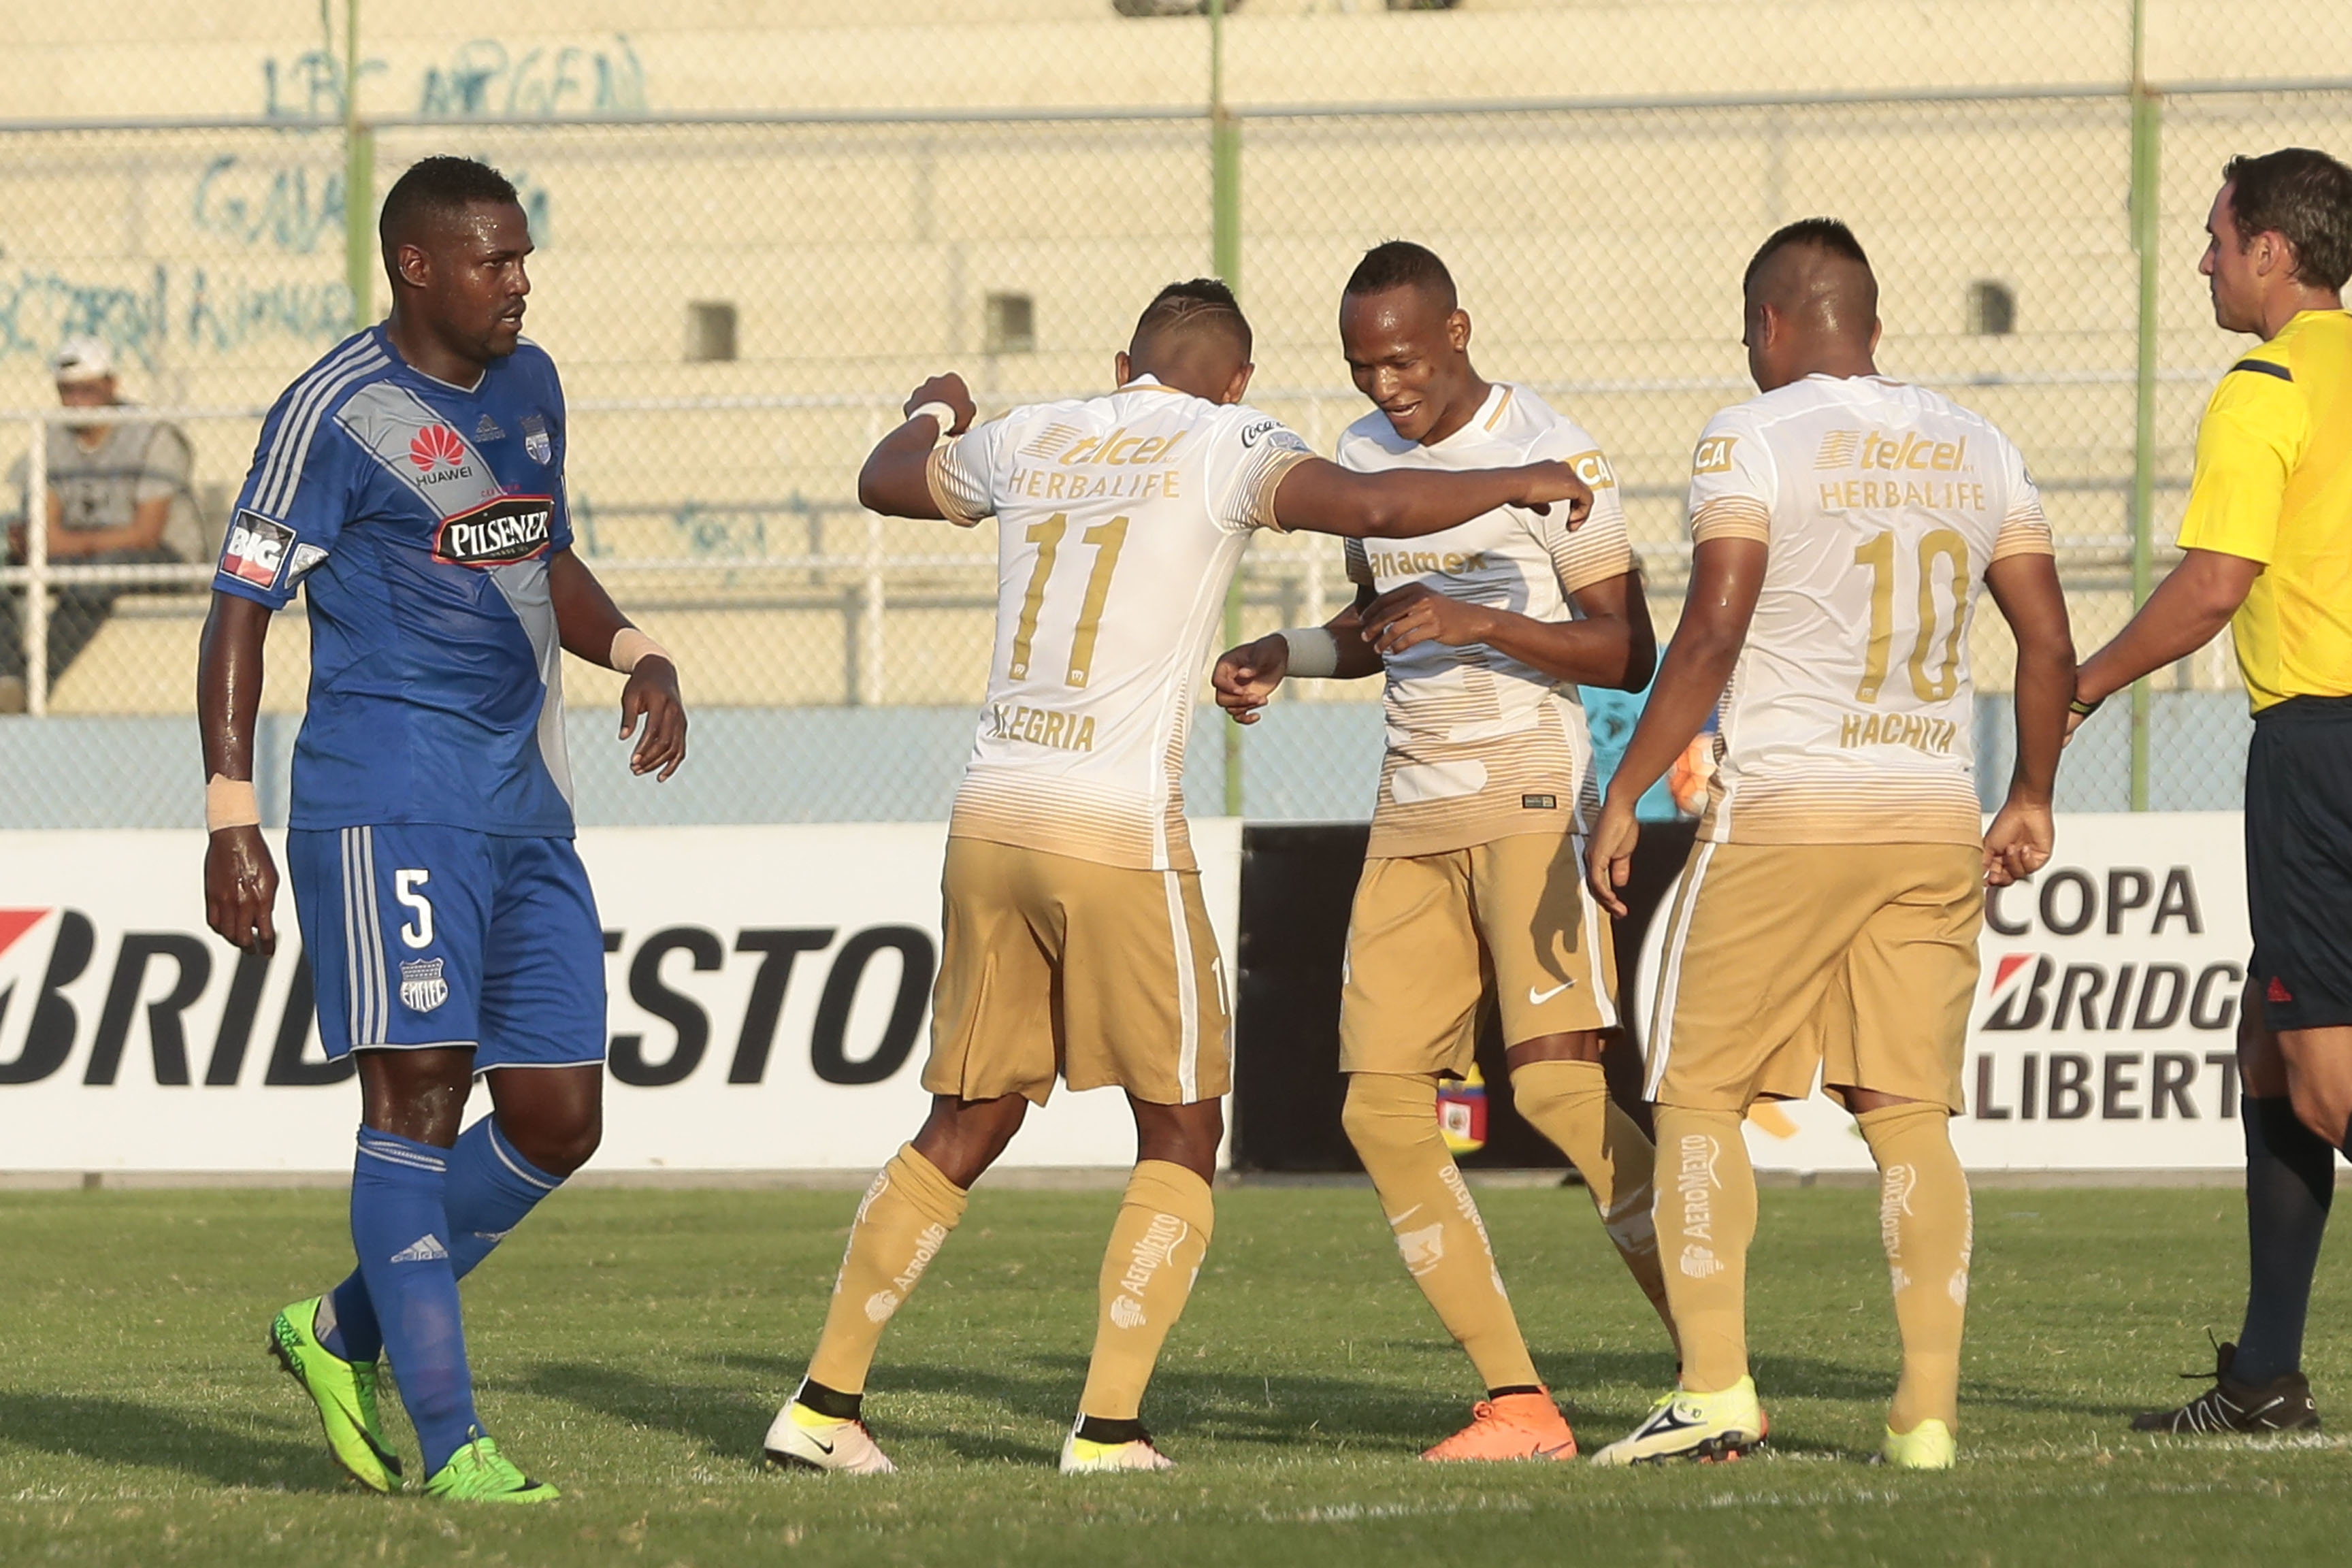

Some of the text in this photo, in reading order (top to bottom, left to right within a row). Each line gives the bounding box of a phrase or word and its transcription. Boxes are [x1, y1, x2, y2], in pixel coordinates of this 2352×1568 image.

[1576, 455, 1612, 485] CA
[1696, 441, 1726, 468] CA
[1861, 431, 1967, 472] telcel
[416, 466, 472, 487] HUAWEI
[1007, 468, 1180, 500] HERBALIFE
[1820, 480, 1986, 511] HERBALIFE
[227, 527, 283, 572] BIG
[451, 511, 549, 557] PILSENER
[1370, 551, 1489, 578] anamex
[1009, 512, 1130, 688] 11
[1855, 529, 1970, 704] 10
[1840, 713, 1958, 753] HACHITA
[395, 870, 434, 949] 5
[1984, 866, 2204, 936] COPA
[1975, 1052, 2238, 1120] LIBERT
[1678, 1134, 1712, 1241] AEROMEXICO
[893, 1222, 949, 1292] AEROME
